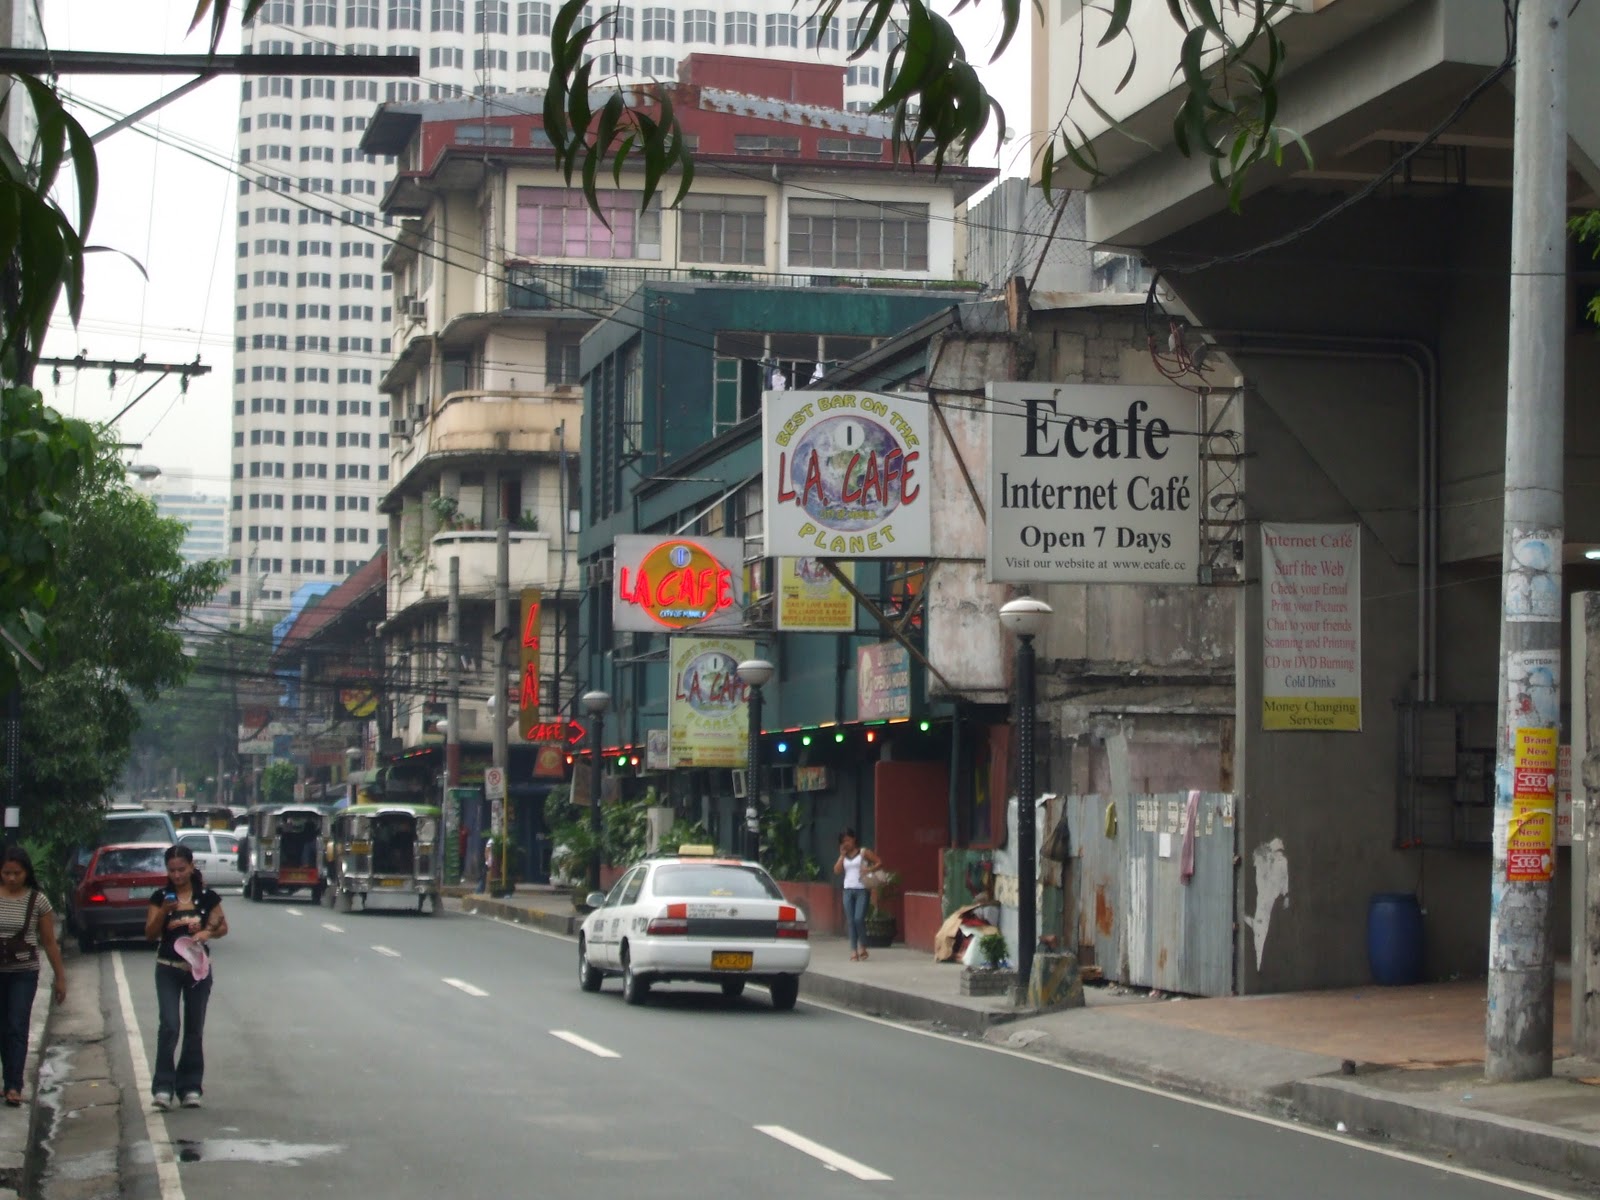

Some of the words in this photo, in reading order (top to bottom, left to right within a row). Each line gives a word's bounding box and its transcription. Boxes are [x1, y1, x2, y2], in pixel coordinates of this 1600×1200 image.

[775, 403, 814, 447] BEST
[817, 394, 857, 412] BAR
[860, 397, 888, 417] ON
[891, 411, 920, 449] THE
[1020, 399, 1170, 460] Ecafe
[777, 448, 830, 507] L.A.
[841, 447, 920, 507] CAFE
[1000, 472, 1118, 511] Internet
[1127, 475, 1191, 511] Café
[797, 522, 896, 554] PLANET
[1020, 525, 1086, 553] Open
[1093, 526, 1106, 548] 7
[1117, 527, 1171, 554] Days
[1264, 534, 1317, 548] Internet
[1321, 531, 1353, 548] Café
[1005, 557, 1030, 569] Visit
[1033, 560, 1051, 569] our
[1055, 558, 1095, 569] website
[1097, 559, 1108, 570] at
[1112, 559, 1186, 571] www.ecafe.cc
[1274, 560, 1300, 576] Surf
[1301, 560, 1317, 576] the
[1320, 560, 1345, 576] Web
[656, 566, 735, 609] CAFE
[1270, 580, 1298, 595] Check
[1301, 584, 1320, 598] your
[1322, 582, 1348, 596] Email
[1271, 599, 1292, 612] Print
[1294, 602, 1313, 616] your
[1315, 600, 1348, 613] Pictures
[1266, 617, 1288, 631] Chat
[1290, 619, 1298, 631] to
[1301, 621, 1320, 635] your
[1323, 619, 1352, 632] friends
[1264, 637, 1303, 652] Scanning
[1305, 638, 1320, 649] and
[1322, 636, 1356, 652] Printing
[1264, 656, 1281, 669] CD
[1283, 659, 1292, 669] or
[1294, 656, 1318, 669] DVD
[1320, 656, 1355, 672] Burning
[1285, 675, 1306, 688] Cold
[1308, 675, 1336, 688] Drinks
[1264, 700, 1300, 715] Money
[1305, 700, 1357, 716] Changing
[1289, 714, 1335, 726] Services
[1523, 736, 1552, 744] Brand
[1527, 747, 1549, 756] New
[1520, 758, 1552, 767] Rooms
[1519, 829, 1542, 837] New
[1513, 840, 1546, 848] Rooms
